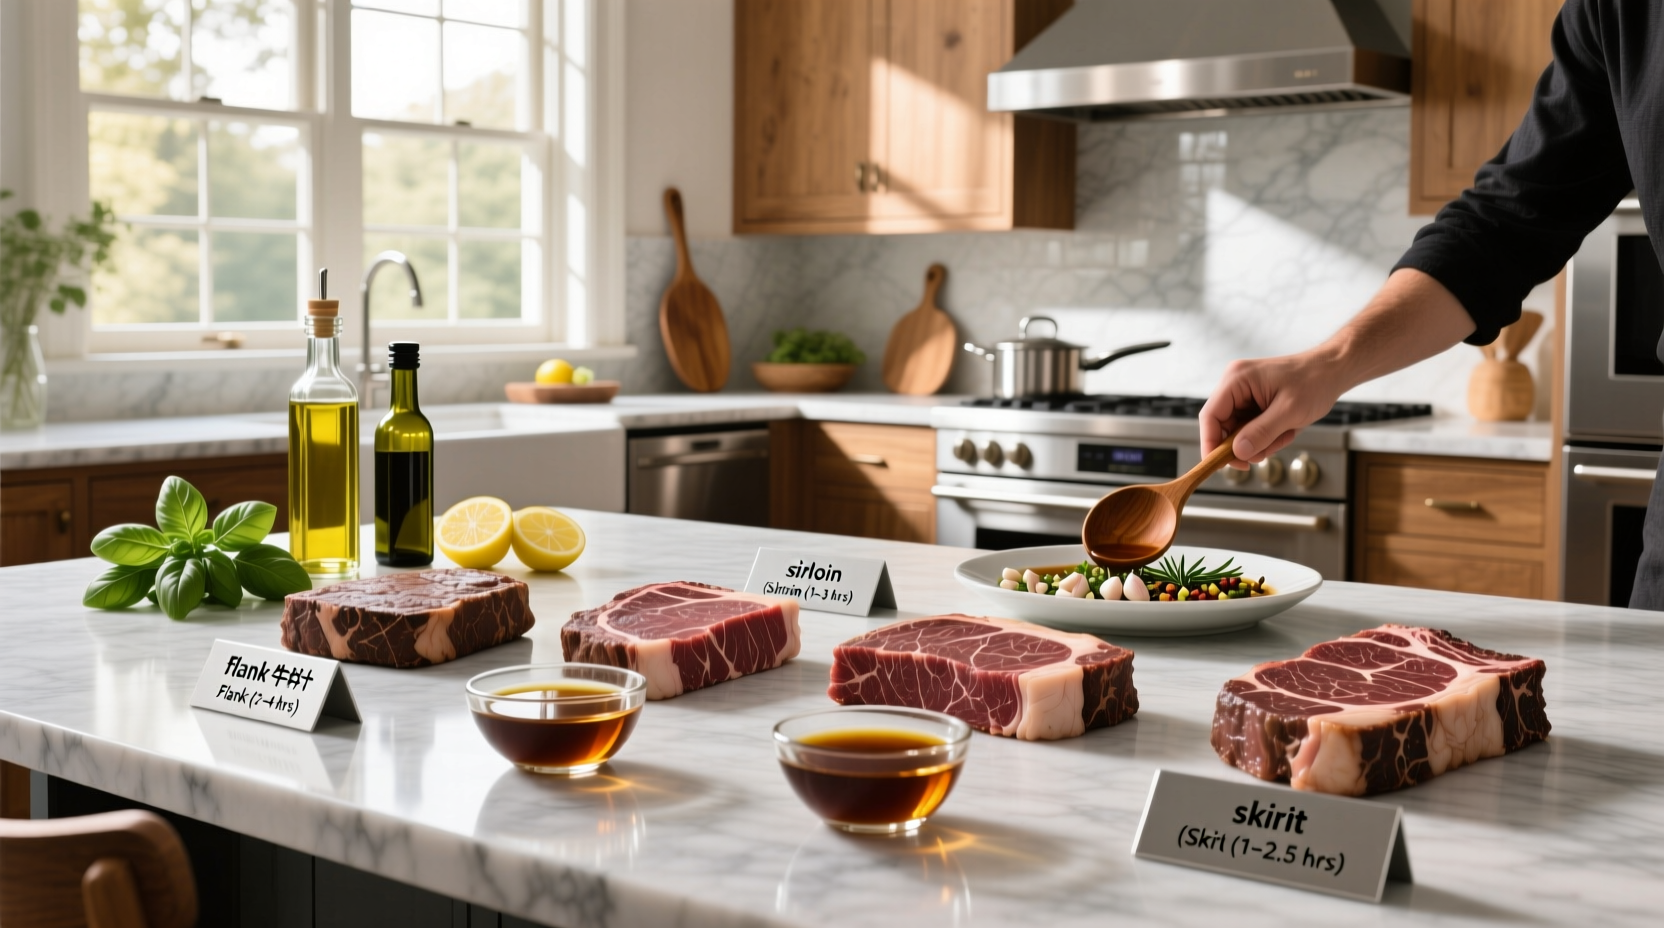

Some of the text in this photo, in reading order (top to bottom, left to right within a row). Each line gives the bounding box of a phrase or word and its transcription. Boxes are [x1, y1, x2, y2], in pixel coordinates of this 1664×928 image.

[786, 559, 842, 582] sirloin
[830, 589, 853, 606] hrs)
[216, 684, 249, 704] Flank
[1232, 800, 1308, 834] skirit
[1302, 847, 1345, 877] hrs)
